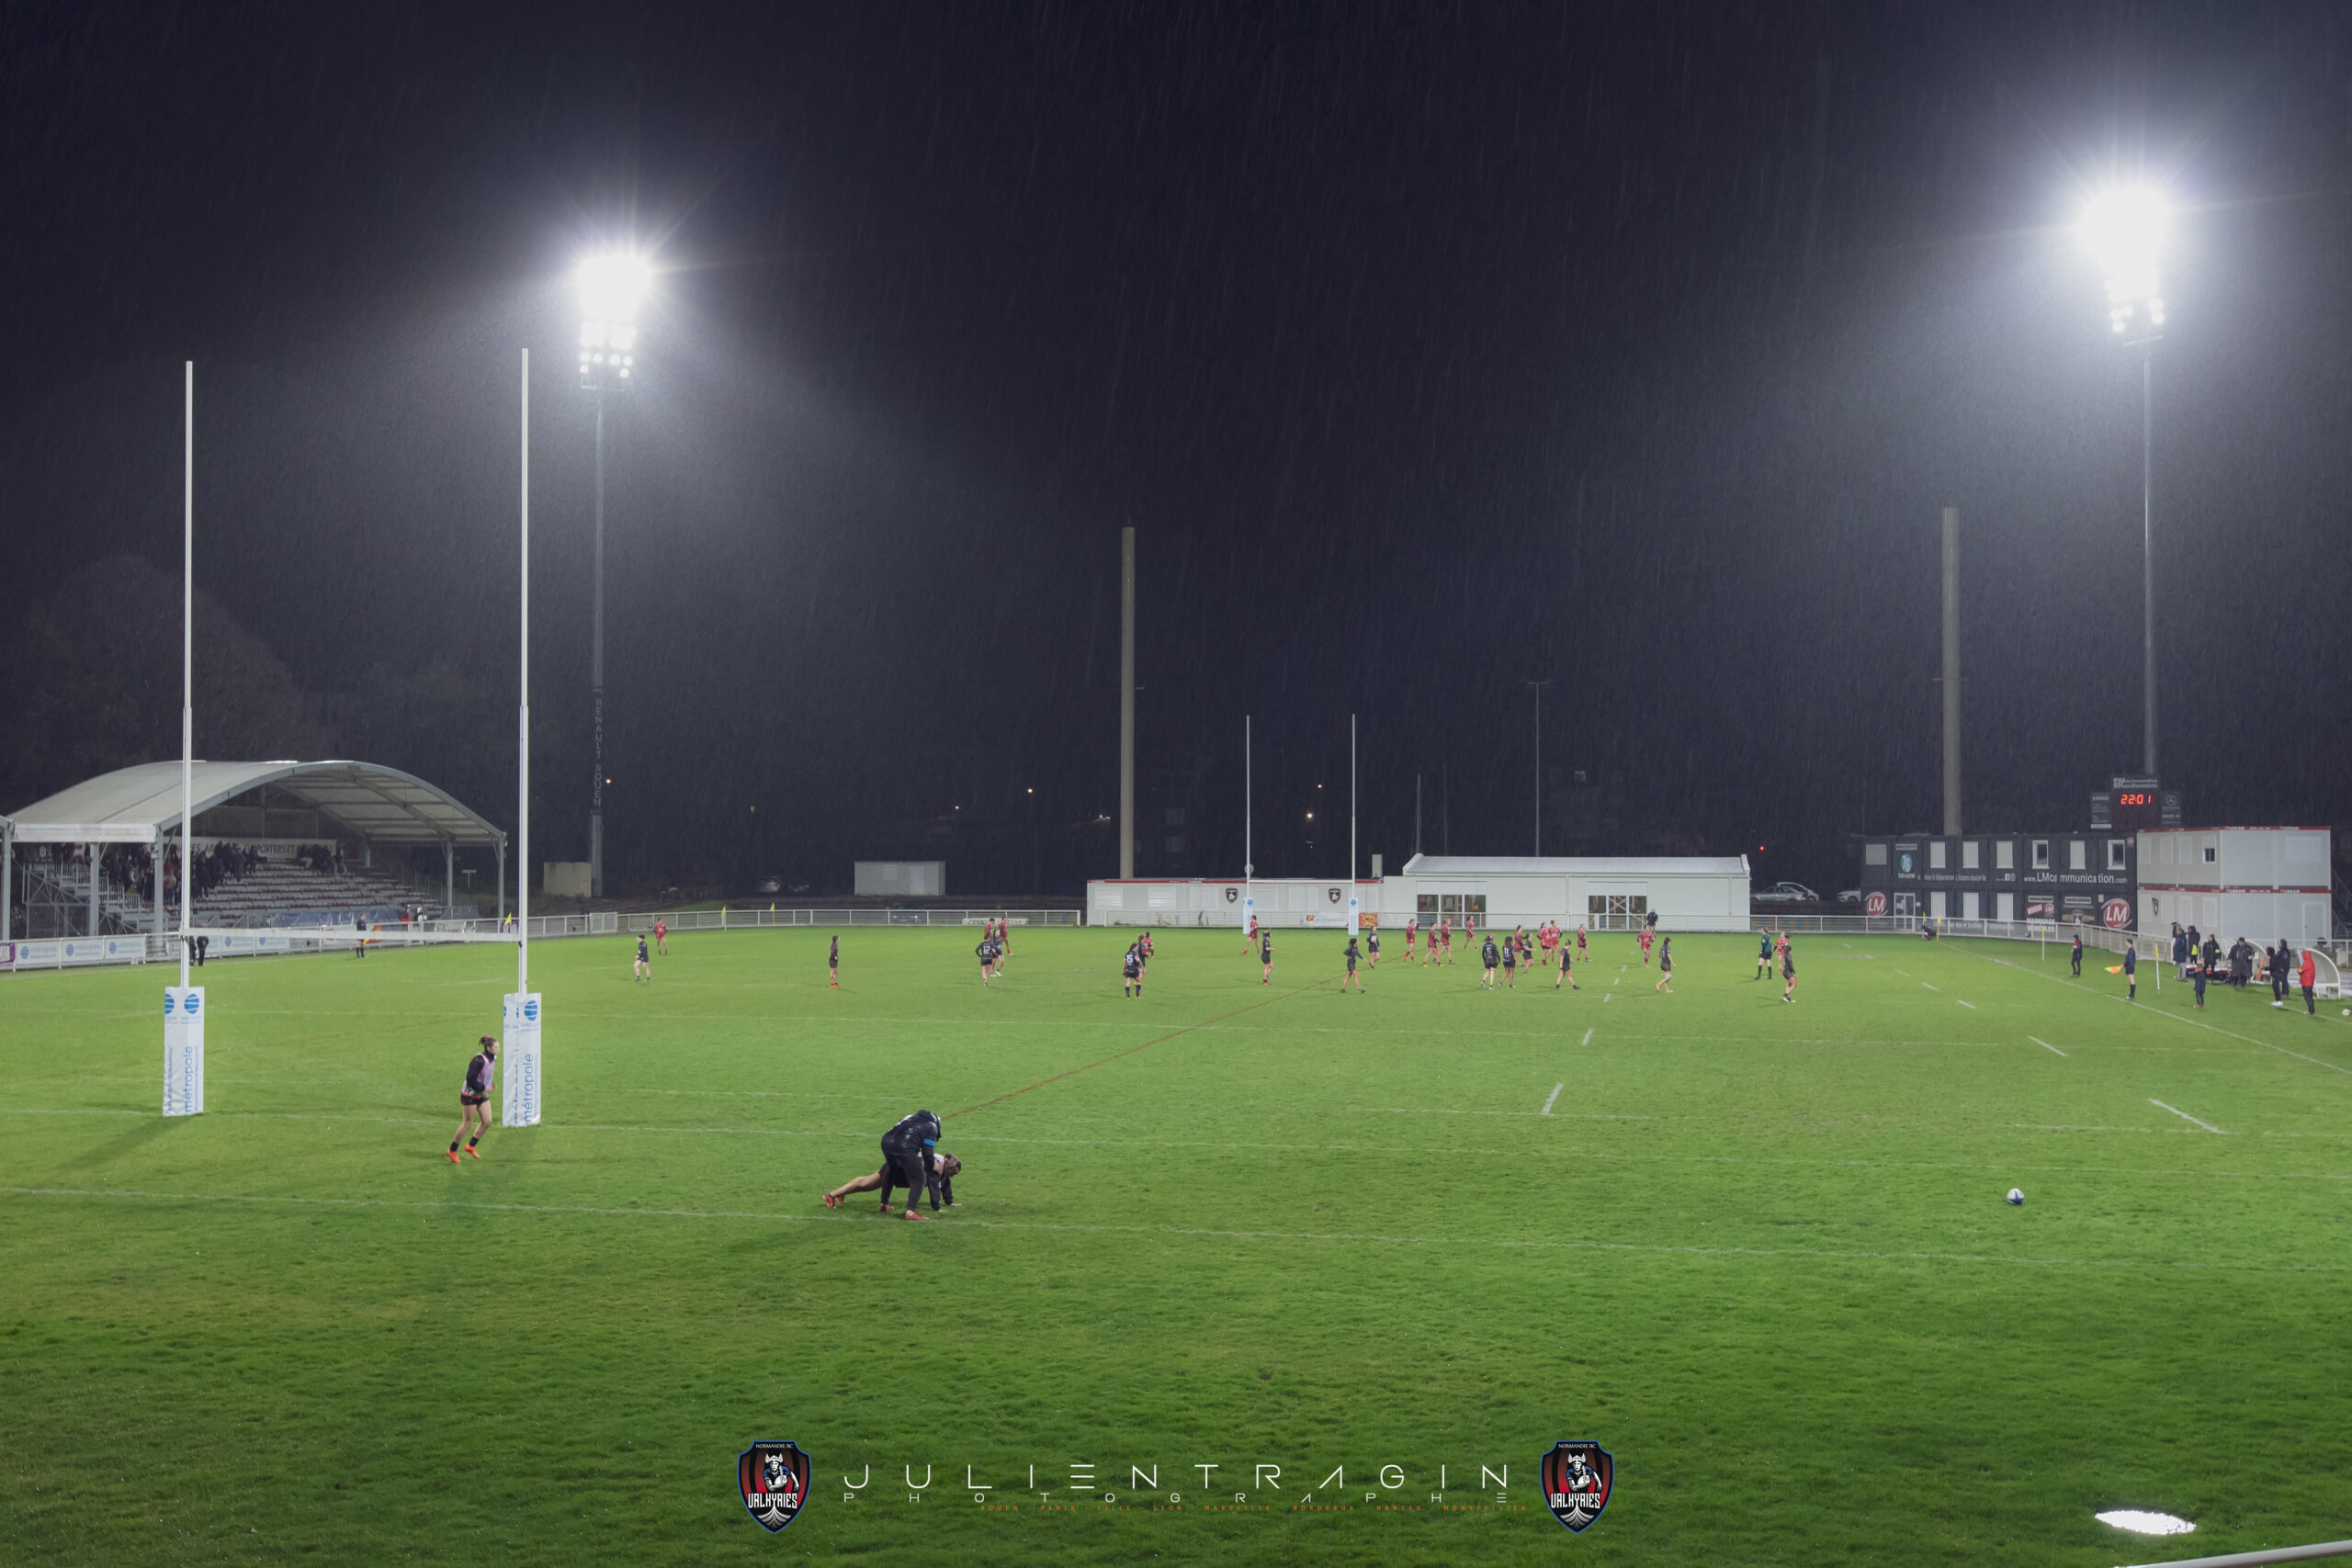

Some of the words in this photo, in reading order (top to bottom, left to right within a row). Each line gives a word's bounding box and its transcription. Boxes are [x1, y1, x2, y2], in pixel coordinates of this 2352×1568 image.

[1868, 897, 1884, 912] LM
[2106, 906, 2128, 922] LM
[1125, 954, 1134, 964] 15
